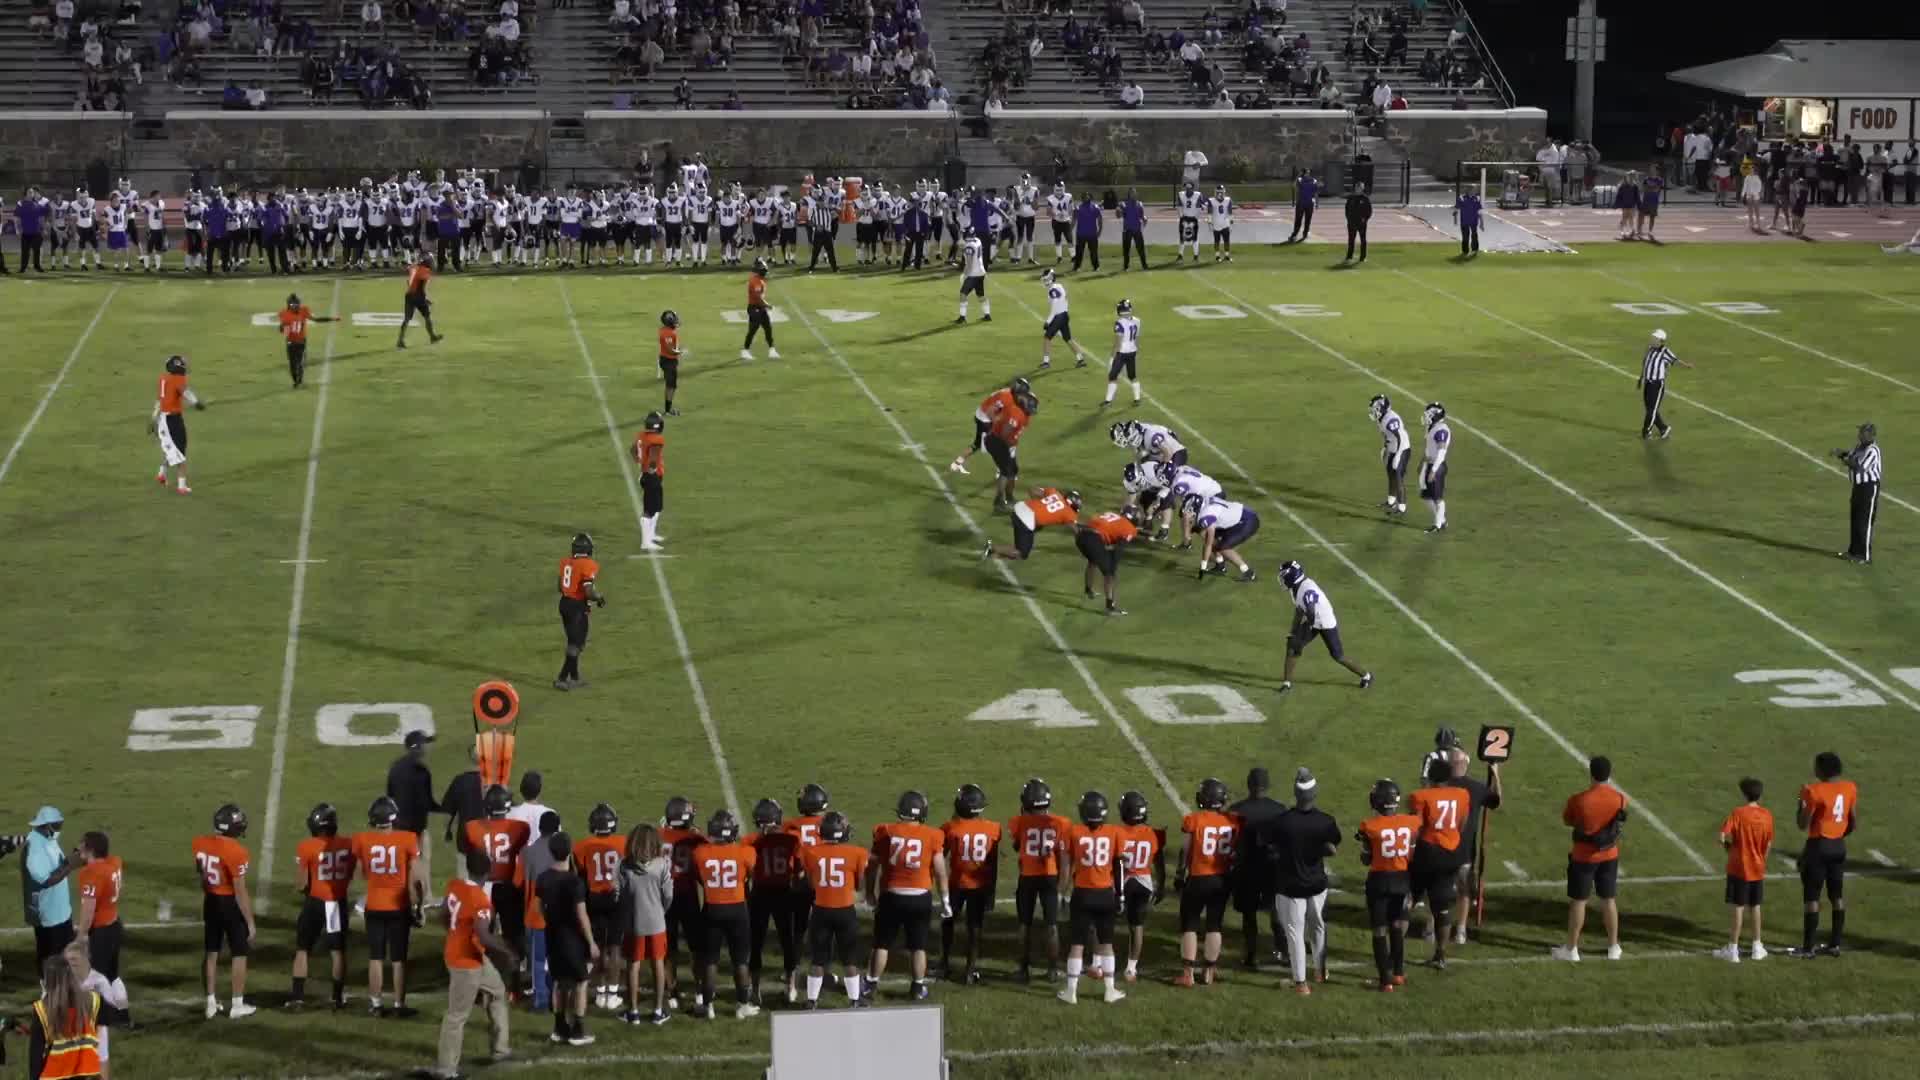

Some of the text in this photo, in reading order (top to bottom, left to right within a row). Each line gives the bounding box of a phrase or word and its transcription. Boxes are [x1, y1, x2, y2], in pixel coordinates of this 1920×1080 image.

[1850, 107, 1897, 129] FOOD
[563, 565, 572, 588] 8
[965, 684, 1267, 728] 40
[125, 702, 436, 751] 50
[1484, 728, 1510, 757] 2
[1435, 800, 1457, 830] 71
[1832, 794, 1844, 823] 4
[483, 833, 512, 863] 12
[890, 836, 922, 869] 72
[961, 833, 988, 862] 18
[1079, 836, 1111, 867] 38
[1202, 826, 1232, 856] 62
[1381, 827, 1411, 858] 23
[318, 850, 349, 880] 25
[370, 845, 398, 875] 21
[592, 850, 620, 881] 19
[705, 859, 738, 888] 32
[817, 857, 845, 888] 15
